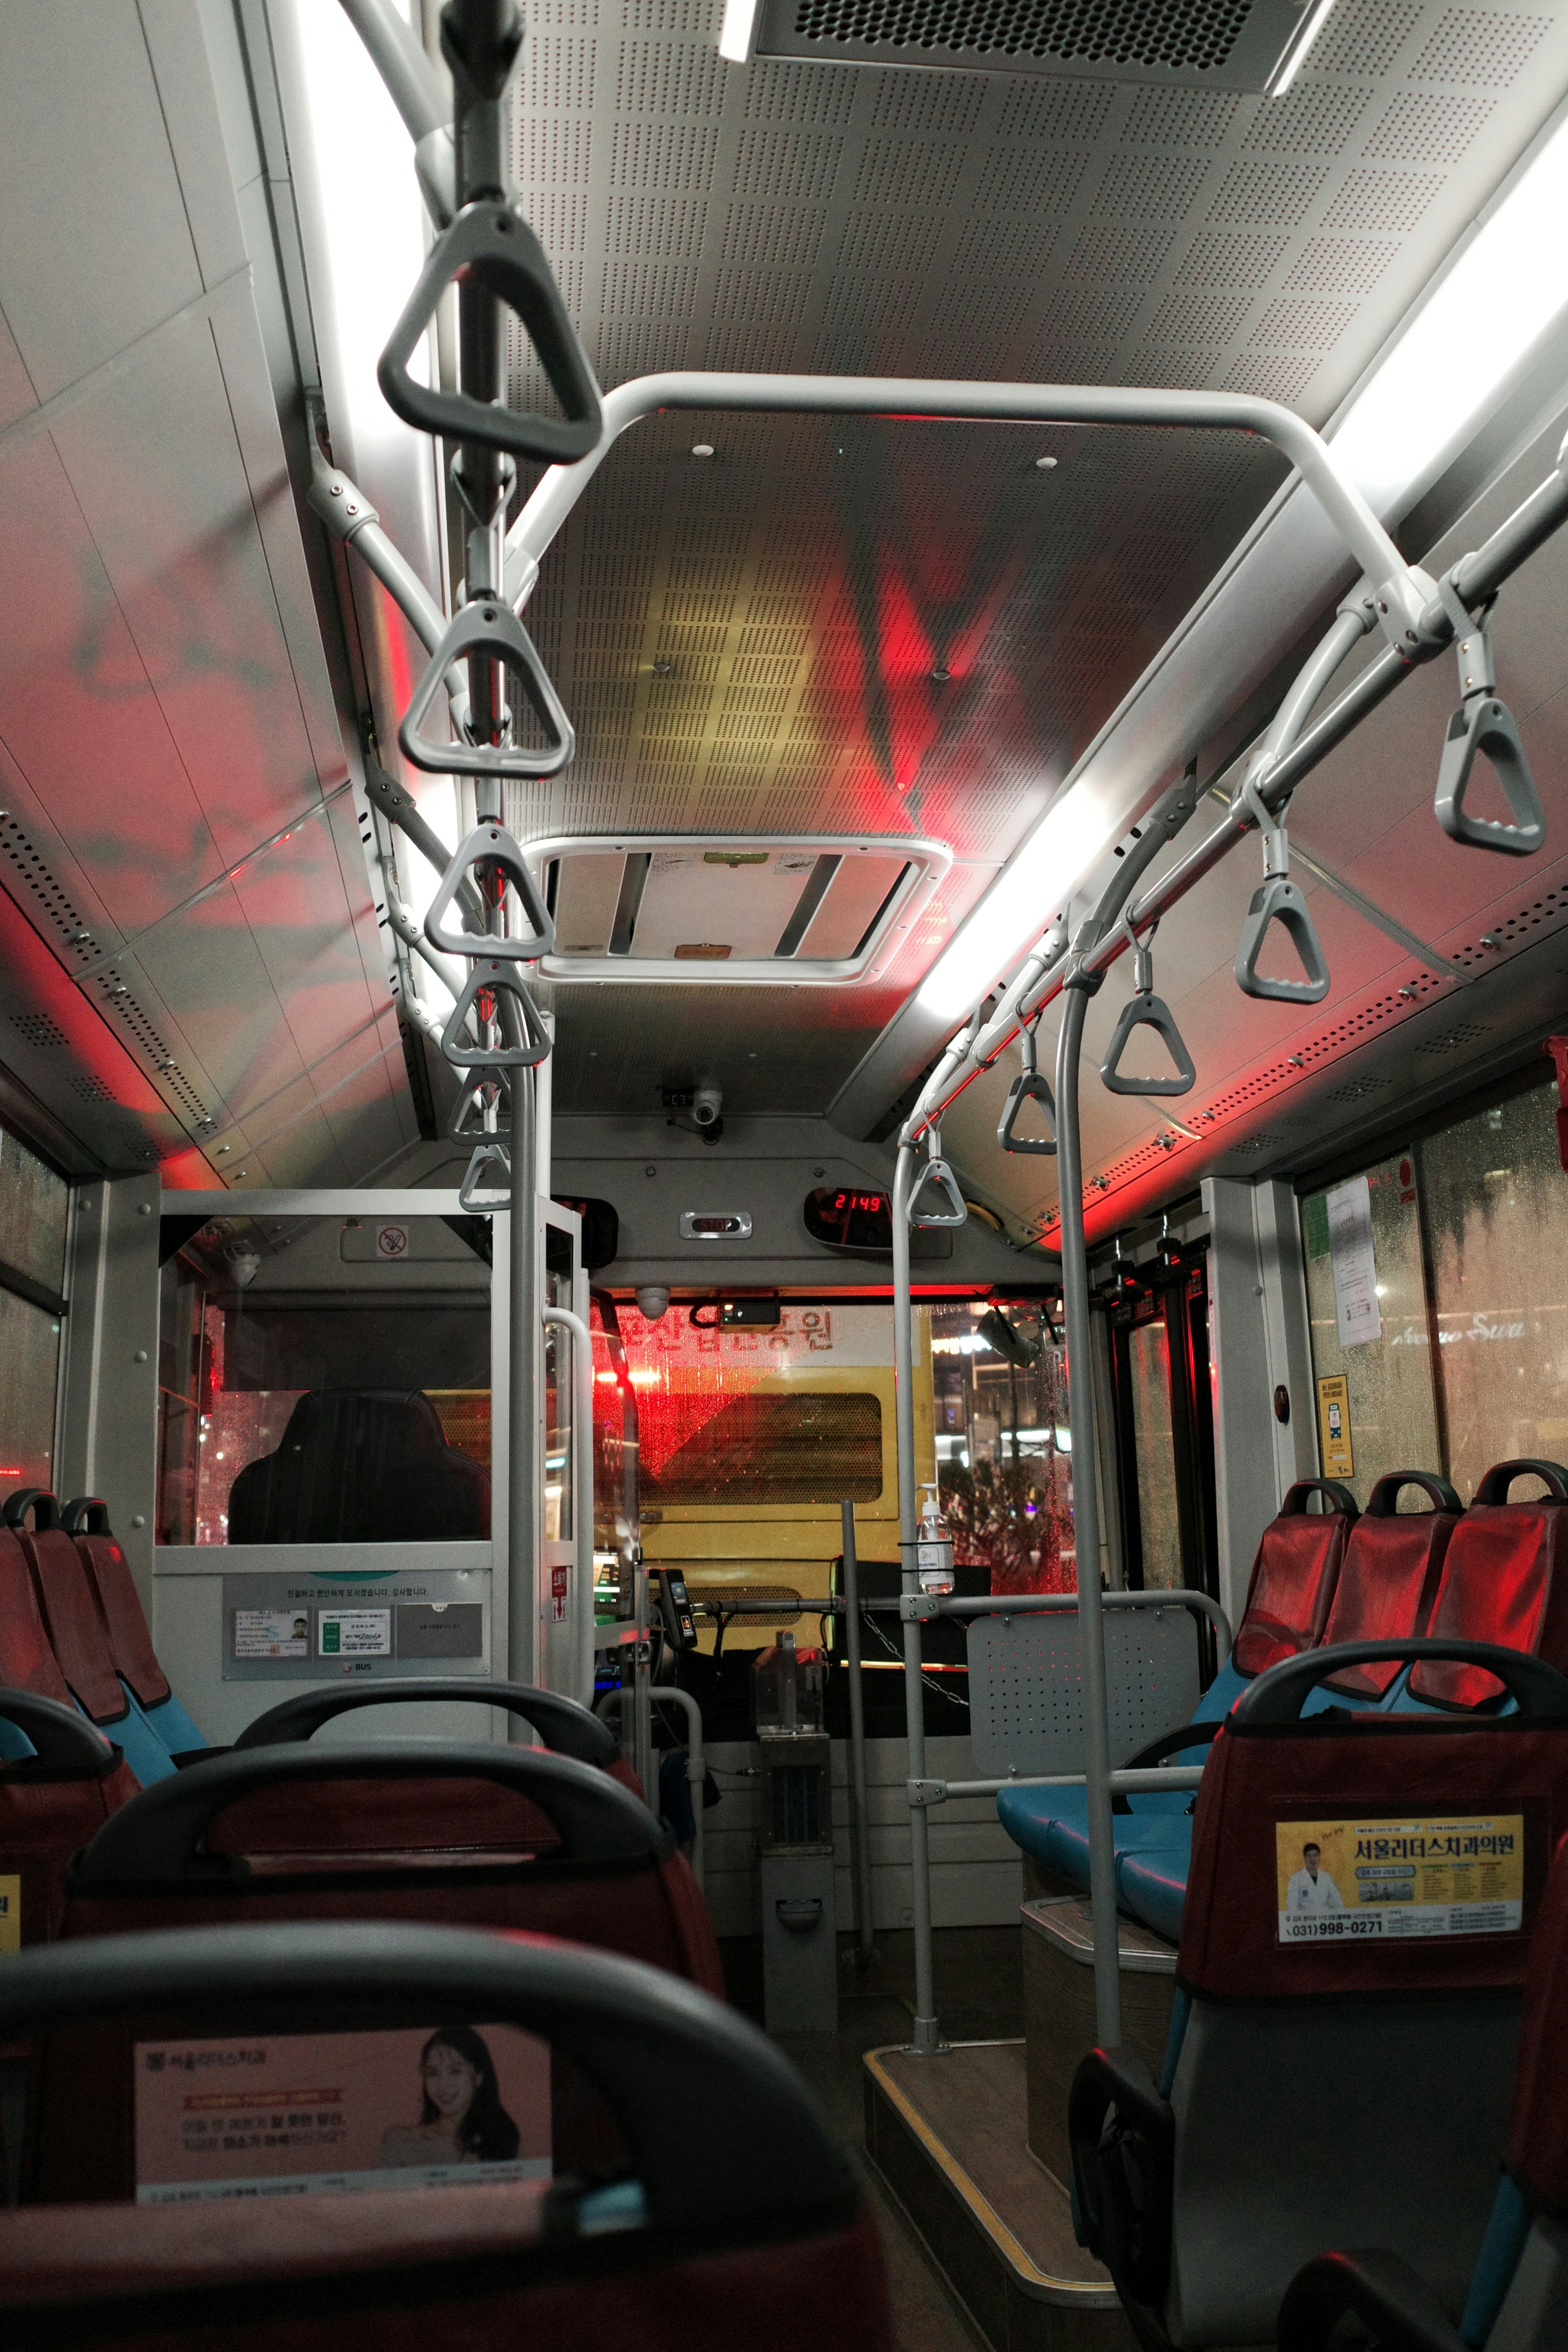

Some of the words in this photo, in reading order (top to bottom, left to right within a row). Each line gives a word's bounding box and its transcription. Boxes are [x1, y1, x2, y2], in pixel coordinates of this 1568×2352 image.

[701, 1219, 732, 1231] STOP
[553, 1571, 566, 1586] 소화기
[317, 1589, 344, 1597] 편안하게
[346, 1588, 390, 1597] 모시겠습니다.
[392, 1588, 429, 1596] 감사합니다.
[1355, 1835, 1514, 1860] 서울리더스치과의원
[1293, 1921, 1383, 1936] 031)998-0271
